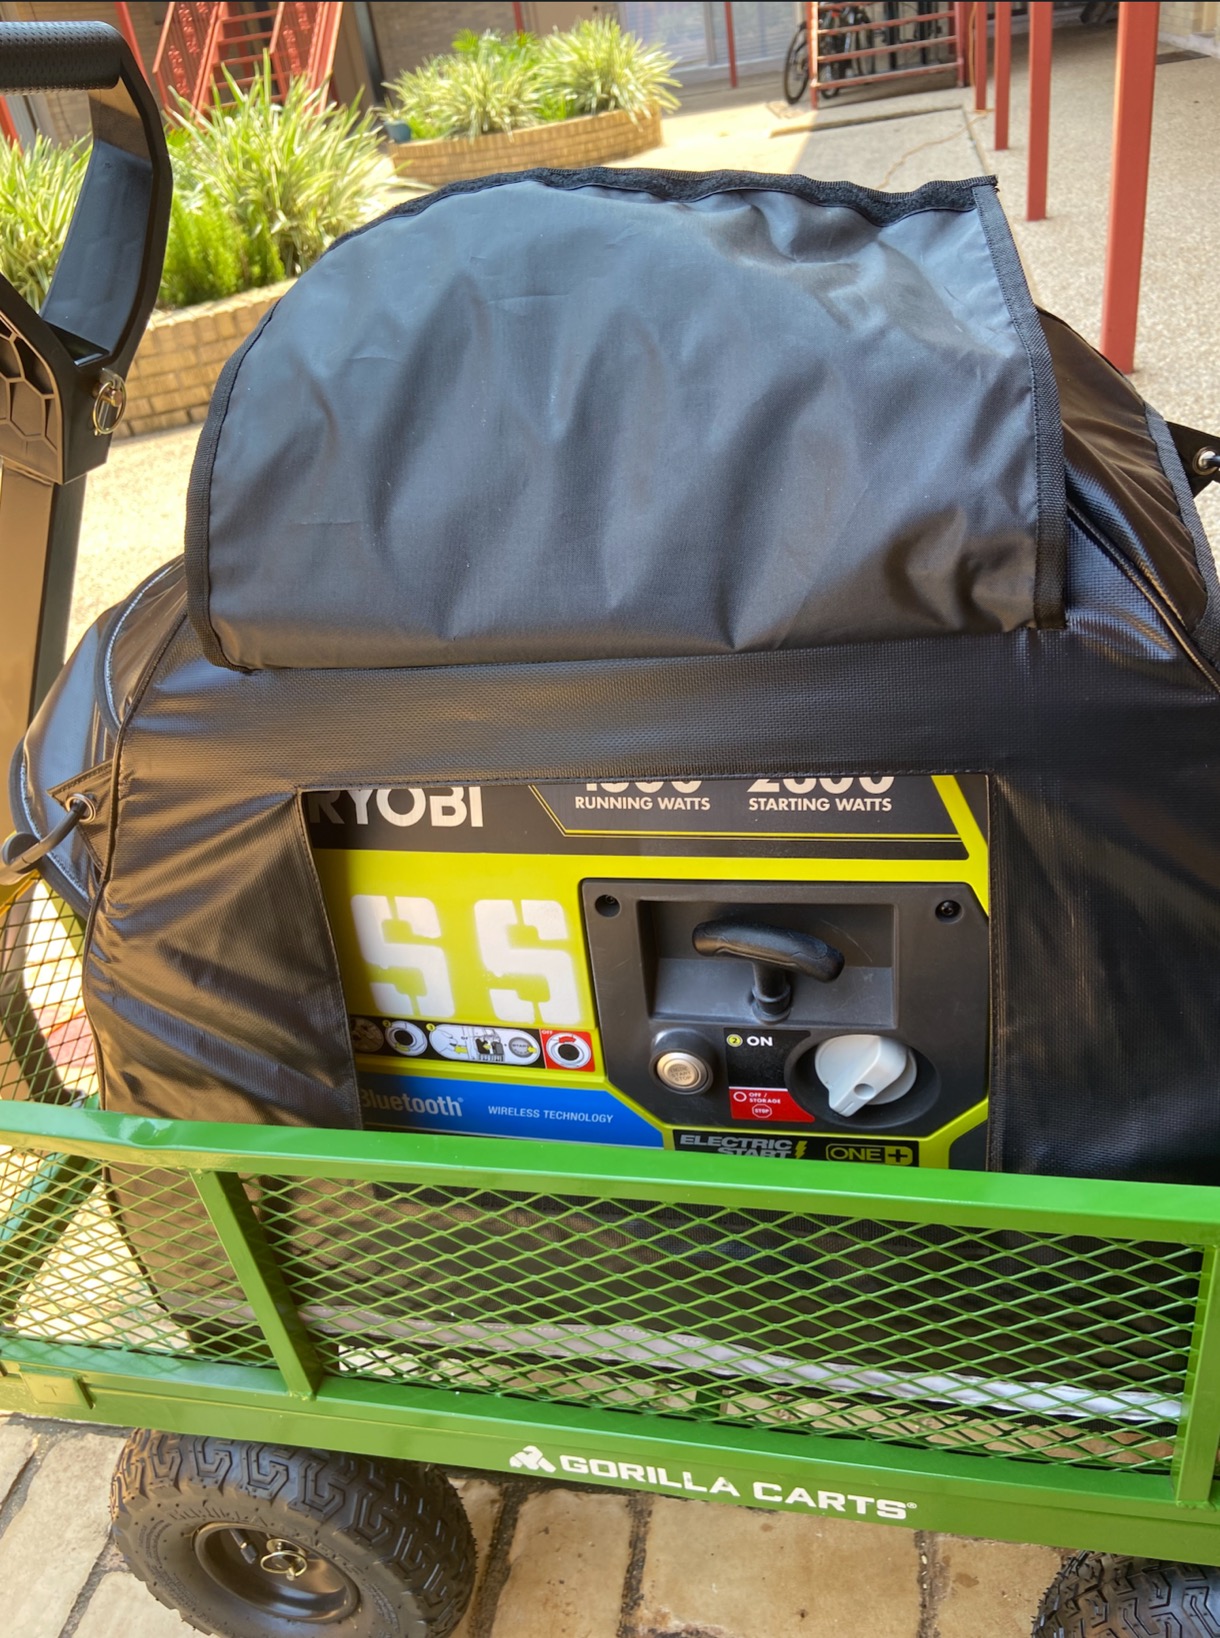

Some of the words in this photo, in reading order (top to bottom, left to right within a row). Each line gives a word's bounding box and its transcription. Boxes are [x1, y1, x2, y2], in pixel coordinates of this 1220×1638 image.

[308, 785, 484, 828] RYOBI
[575, 796, 654, 811] RUNNING
[657, 797, 711, 812] WATTS
[748, 797, 830, 812] STARTING
[835, 798, 893, 813] WATTS
[746, 1035, 774, 1047] ON
[360, 1088, 463, 1117] Bluetooth
[488, 1105, 541, 1119] WIRELESS
[543, 1109, 614, 1124] TECHNOLOGY
[679, 1133, 793, 1151] ELECTRIC
[559, 1454, 741, 1497] GORILLA
